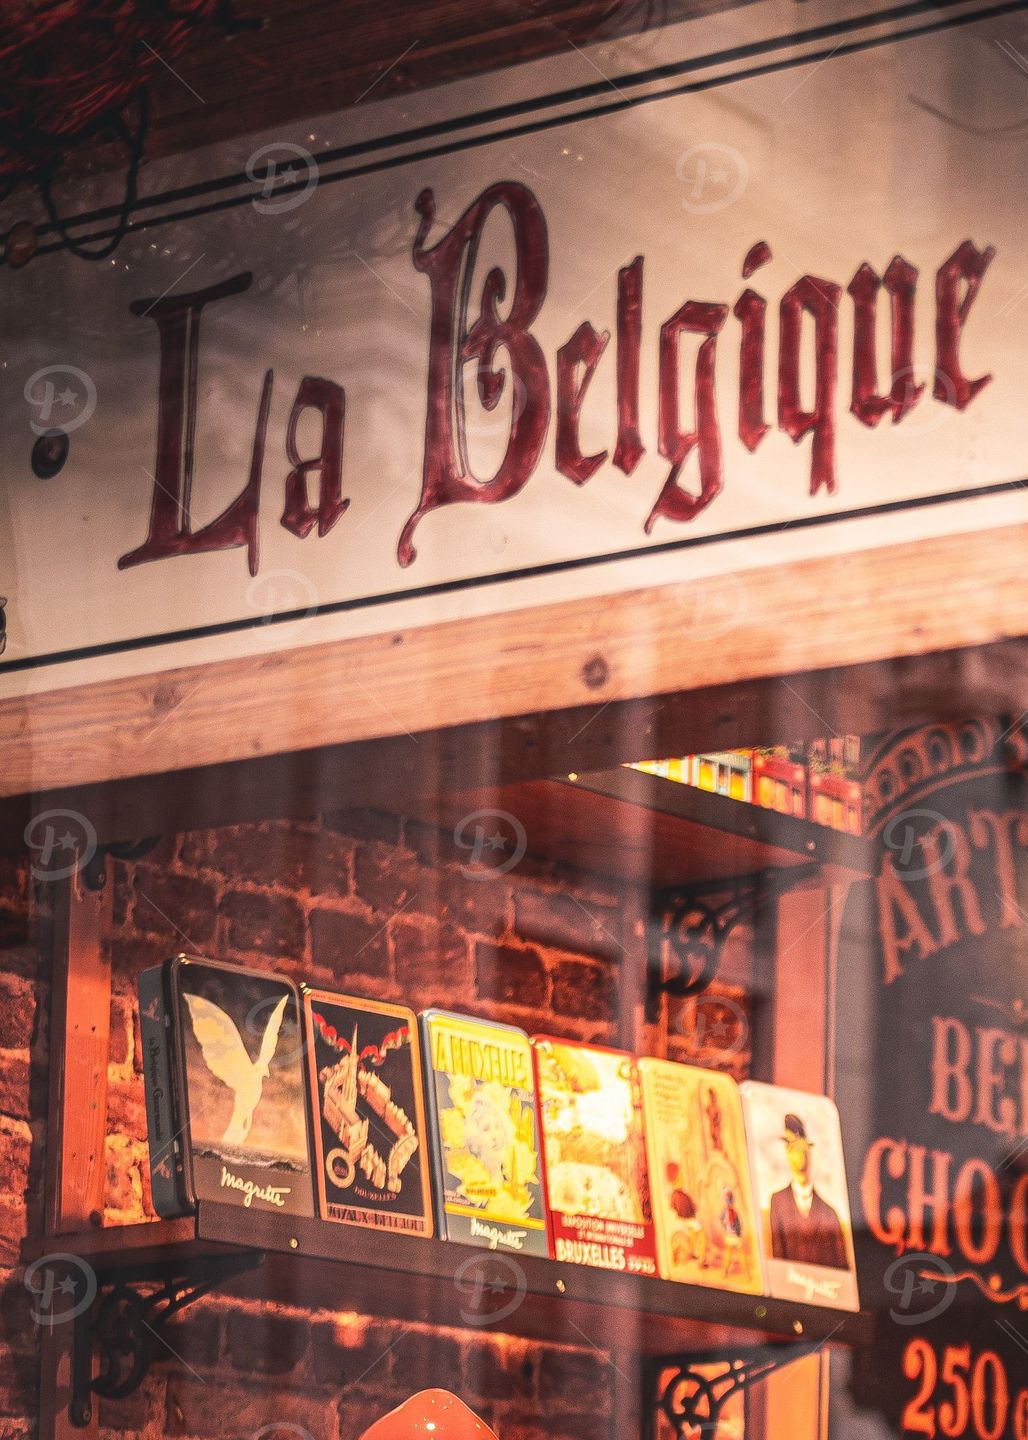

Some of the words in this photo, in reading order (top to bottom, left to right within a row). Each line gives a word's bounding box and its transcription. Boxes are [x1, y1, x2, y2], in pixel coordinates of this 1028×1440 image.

[118, 271, 349, 577] La
[397, 179, 997, 567] Belgique
[556, 1238, 626, 1271] BRUXELLES
